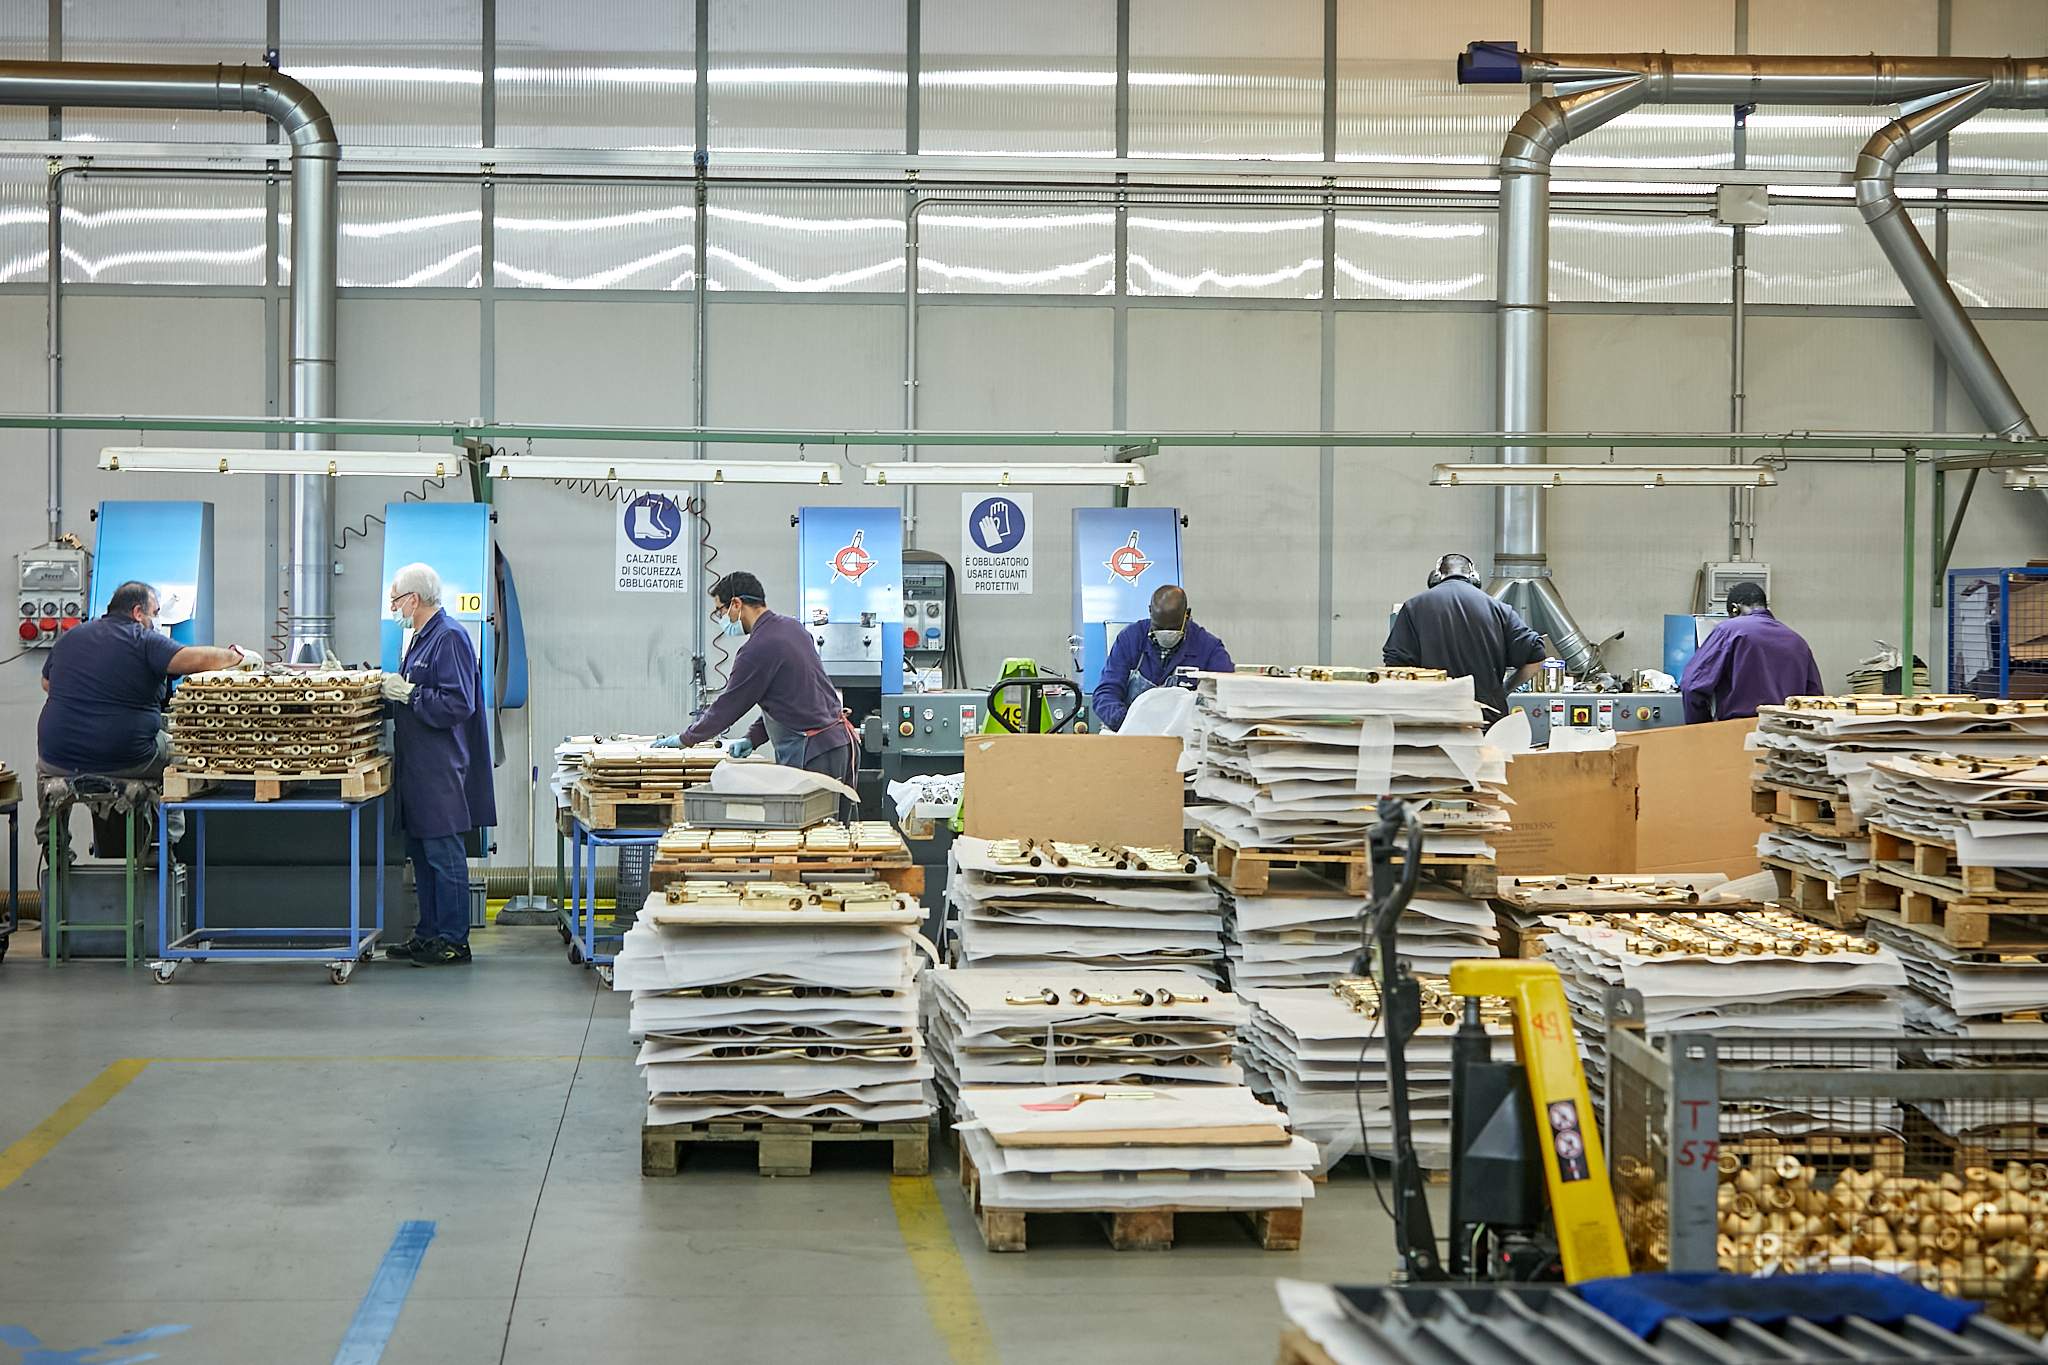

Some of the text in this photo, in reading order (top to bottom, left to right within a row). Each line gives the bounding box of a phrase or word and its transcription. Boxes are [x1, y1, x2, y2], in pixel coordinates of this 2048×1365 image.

[626, 554, 678, 563] CALZATURE
[965, 555, 1029, 567] È OBBLIGATORIO
[622, 566, 682, 576] DI SICUREZZA
[967, 569, 993, 579] USARE
[998, 569, 1028, 579] GUANTI
[619, 578, 684, 588] OBBLIGATORIE
[975, 581, 1019, 591] PROTETTIVI
[461, 595, 481, 611] 10
[1681, 1100, 1711, 1131] T
[1676, 1140, 1720, 1172] 57
